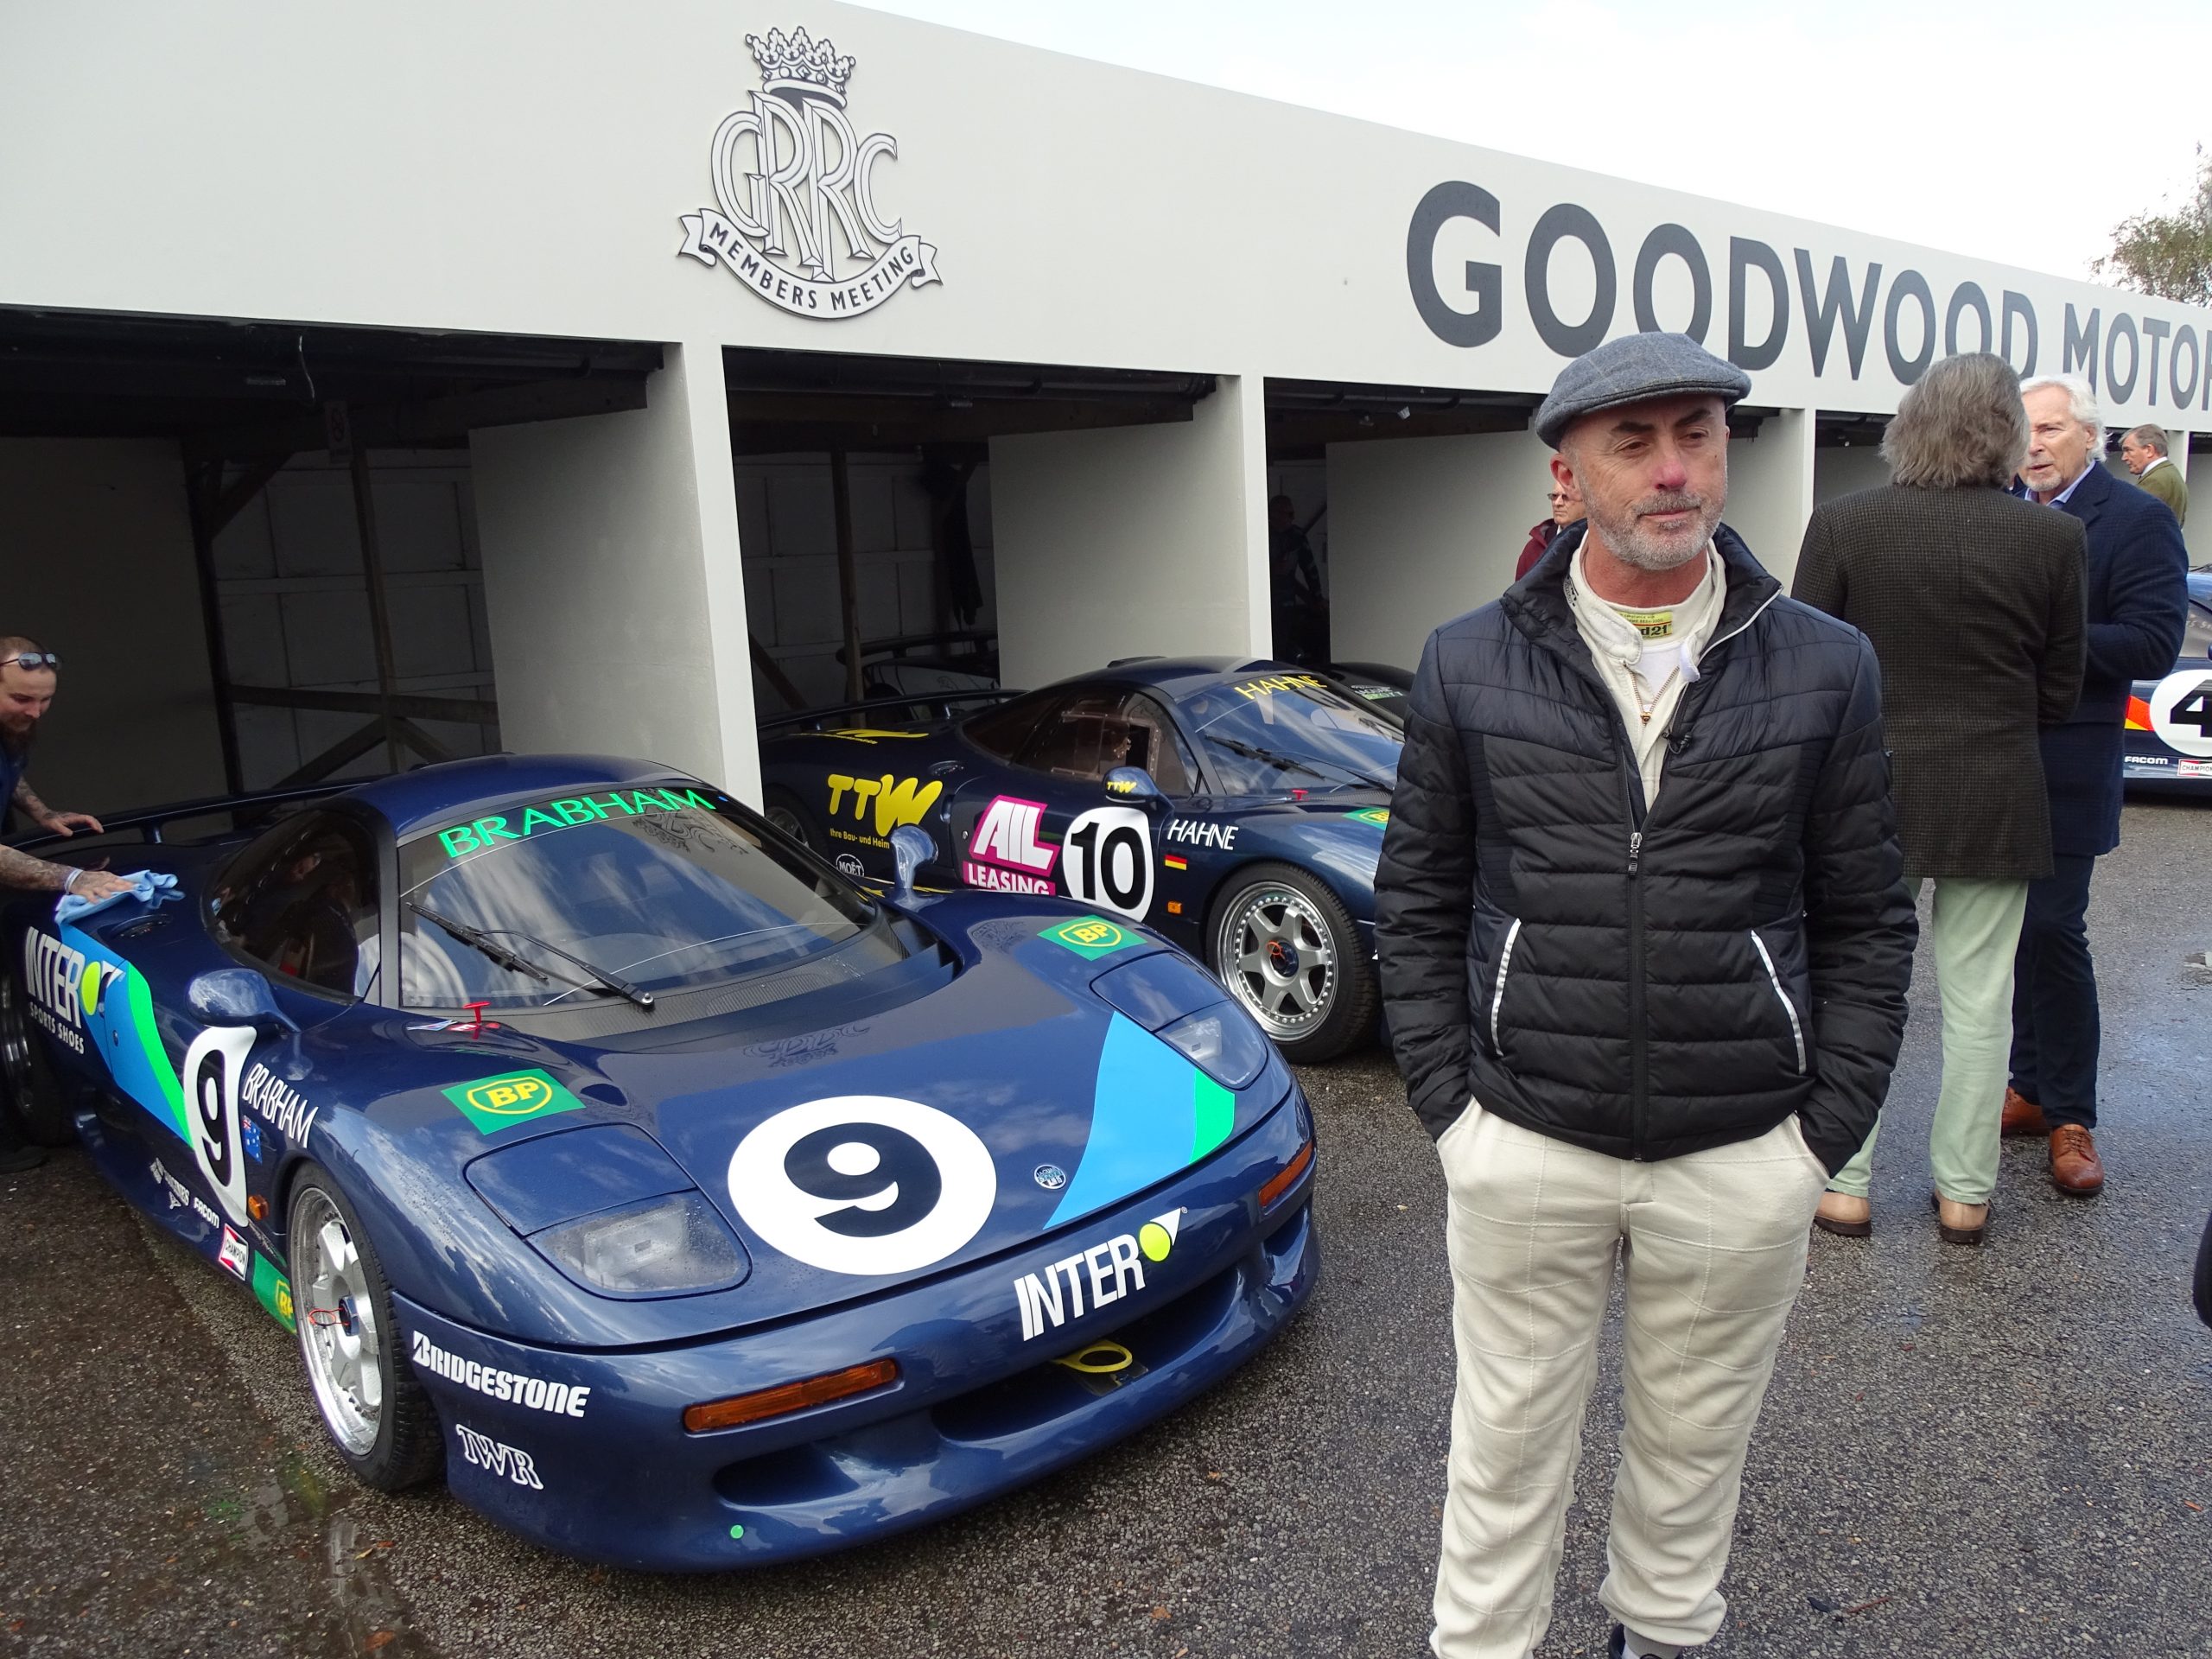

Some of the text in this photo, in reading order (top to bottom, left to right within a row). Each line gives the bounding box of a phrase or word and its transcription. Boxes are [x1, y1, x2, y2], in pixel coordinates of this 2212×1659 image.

[710, 90, 903, 283] GRRC
[708, 221, 914, 311] MEMBERS MEETING
[1407, 180, 2038, 386] GOODWOOD
[1235, 675, 1327, 699] HAHNE
[828, 774, 944, 836] TTW
[1107, 780, 1137, 793] TTW
[438, 788, 716, 858] BRABHAM
[830, 828, 890, 849] Ihre Bau- und Heim
[973, 798, 1055, 871] AIL
[1166, 819, 1240, 851] HAHNE
[968, 863, 1050, 894] LEASING
[1071, 821, 1145, 911] 10
[1072, 924, 1109, 944] BP
[25, 926, 85, 1028] INTER
[29, 1001, 85, 1055] SPORTS SHOES
[197, 1049, 232, 1187] 9
[242, 1063, 319, 1148] BRABHAM
[486, 1082, 539, 1109] BP
[784, 1122, 943, 1238] 9
[226, 1239, 246, 1264] CHAMPION
[1013, 1234, 1146, 1342] INTER
[412, 1330, 591, 1418] BRIDGESTONE
[455, 1423, 544, 1491] TWR
